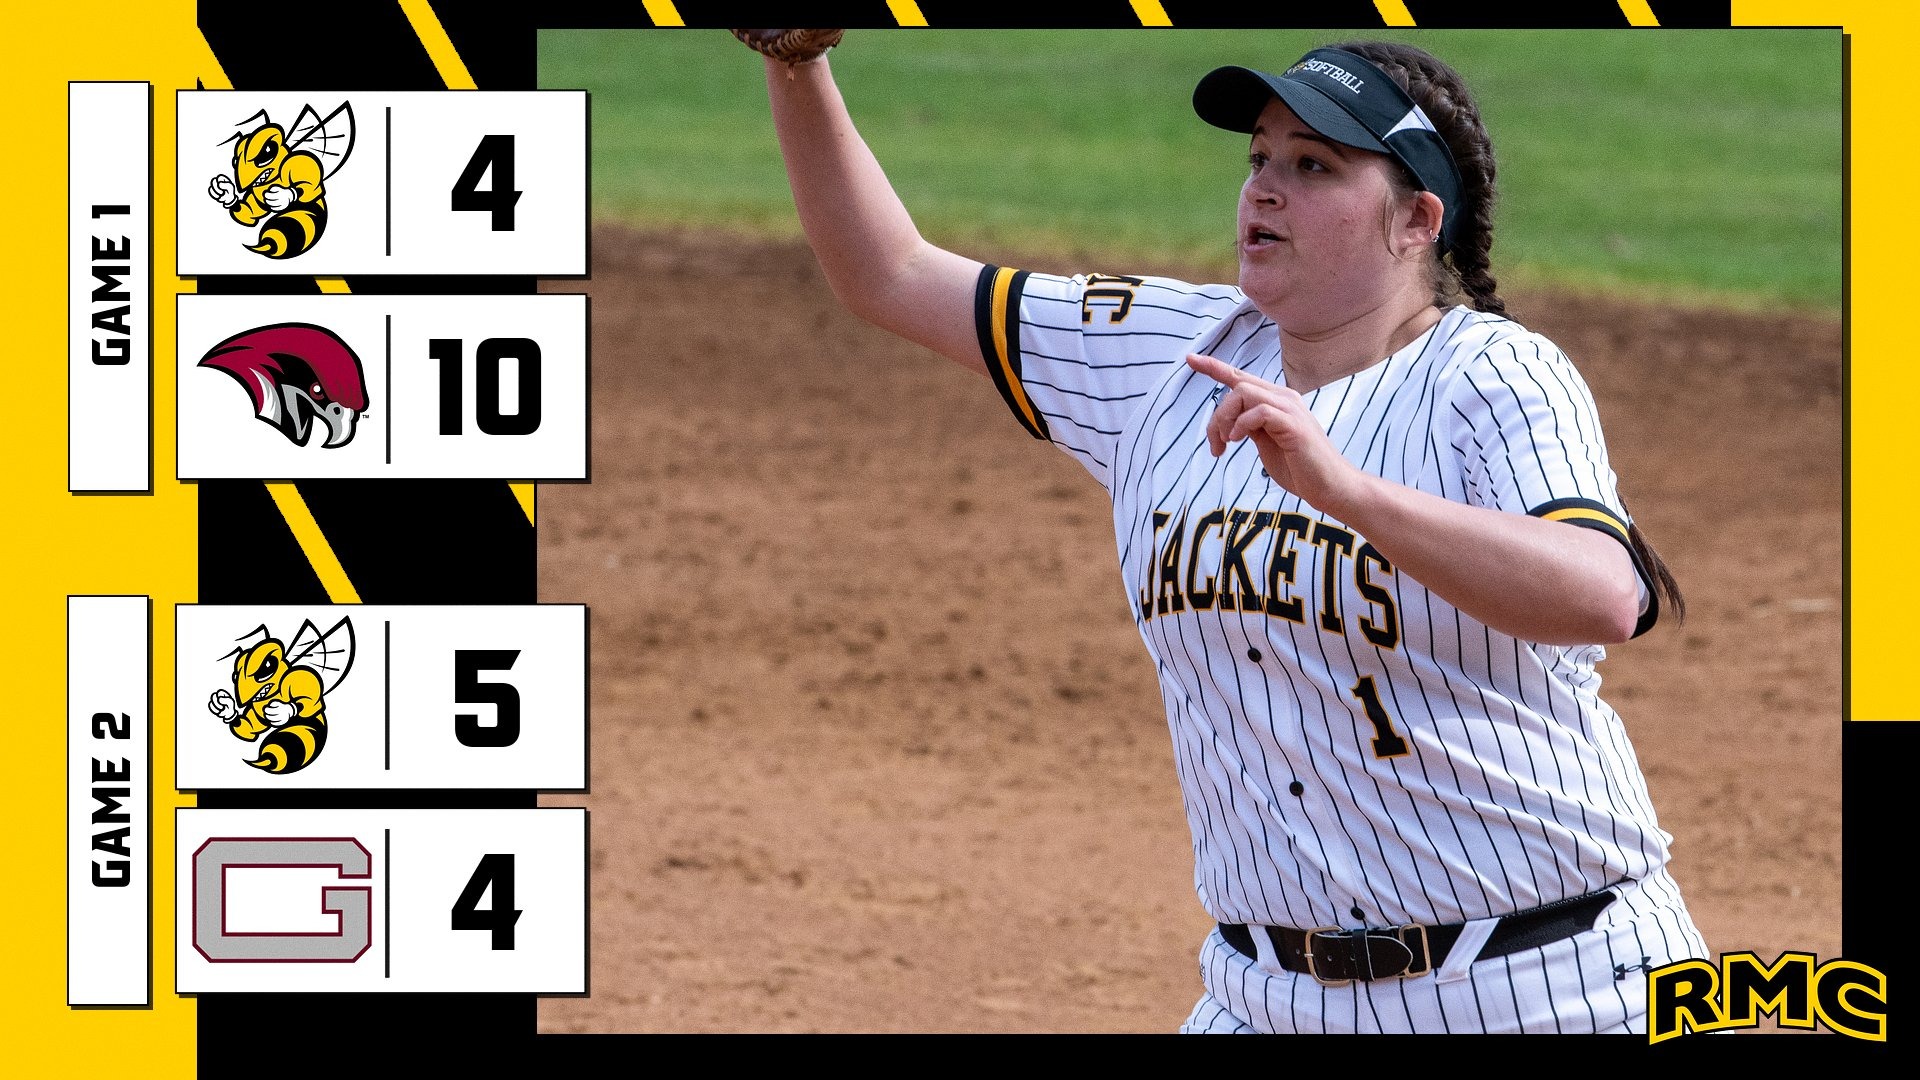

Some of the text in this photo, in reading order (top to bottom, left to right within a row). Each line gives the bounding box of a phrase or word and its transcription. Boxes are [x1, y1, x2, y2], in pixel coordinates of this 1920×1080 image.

[1304, 59, 1365, 95] SOFTBALL
[1140, 505, 1400, 652] JACKETS
[1350, 675, 1411, 760] 1
